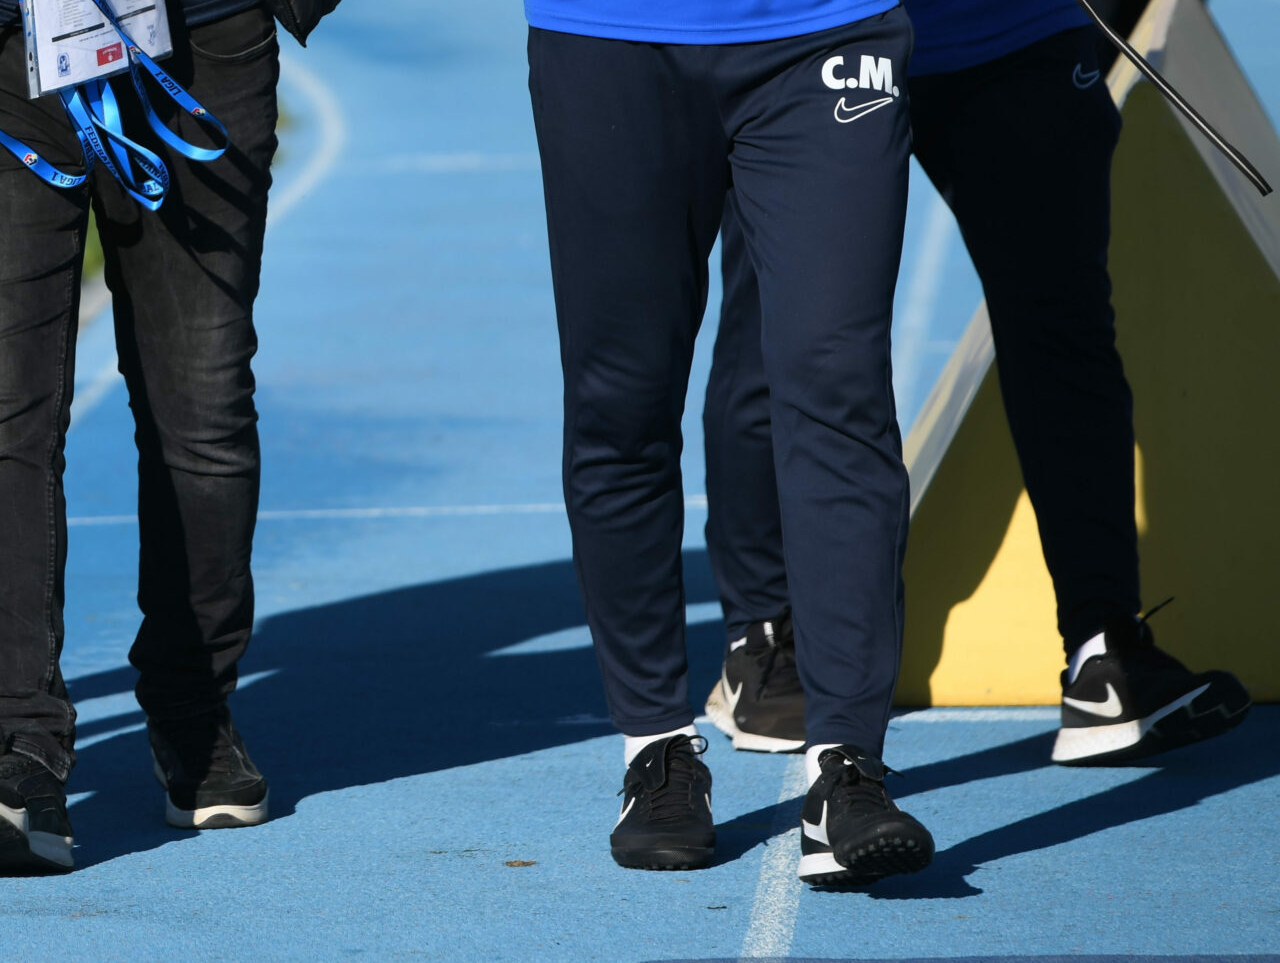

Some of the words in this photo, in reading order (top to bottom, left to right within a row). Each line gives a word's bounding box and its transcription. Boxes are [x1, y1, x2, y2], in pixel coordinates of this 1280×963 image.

[822, 54, 900, 97] C.M.
[160, 77, 182, 96] LIGA
[60, 175, 83, 186] LIGA
